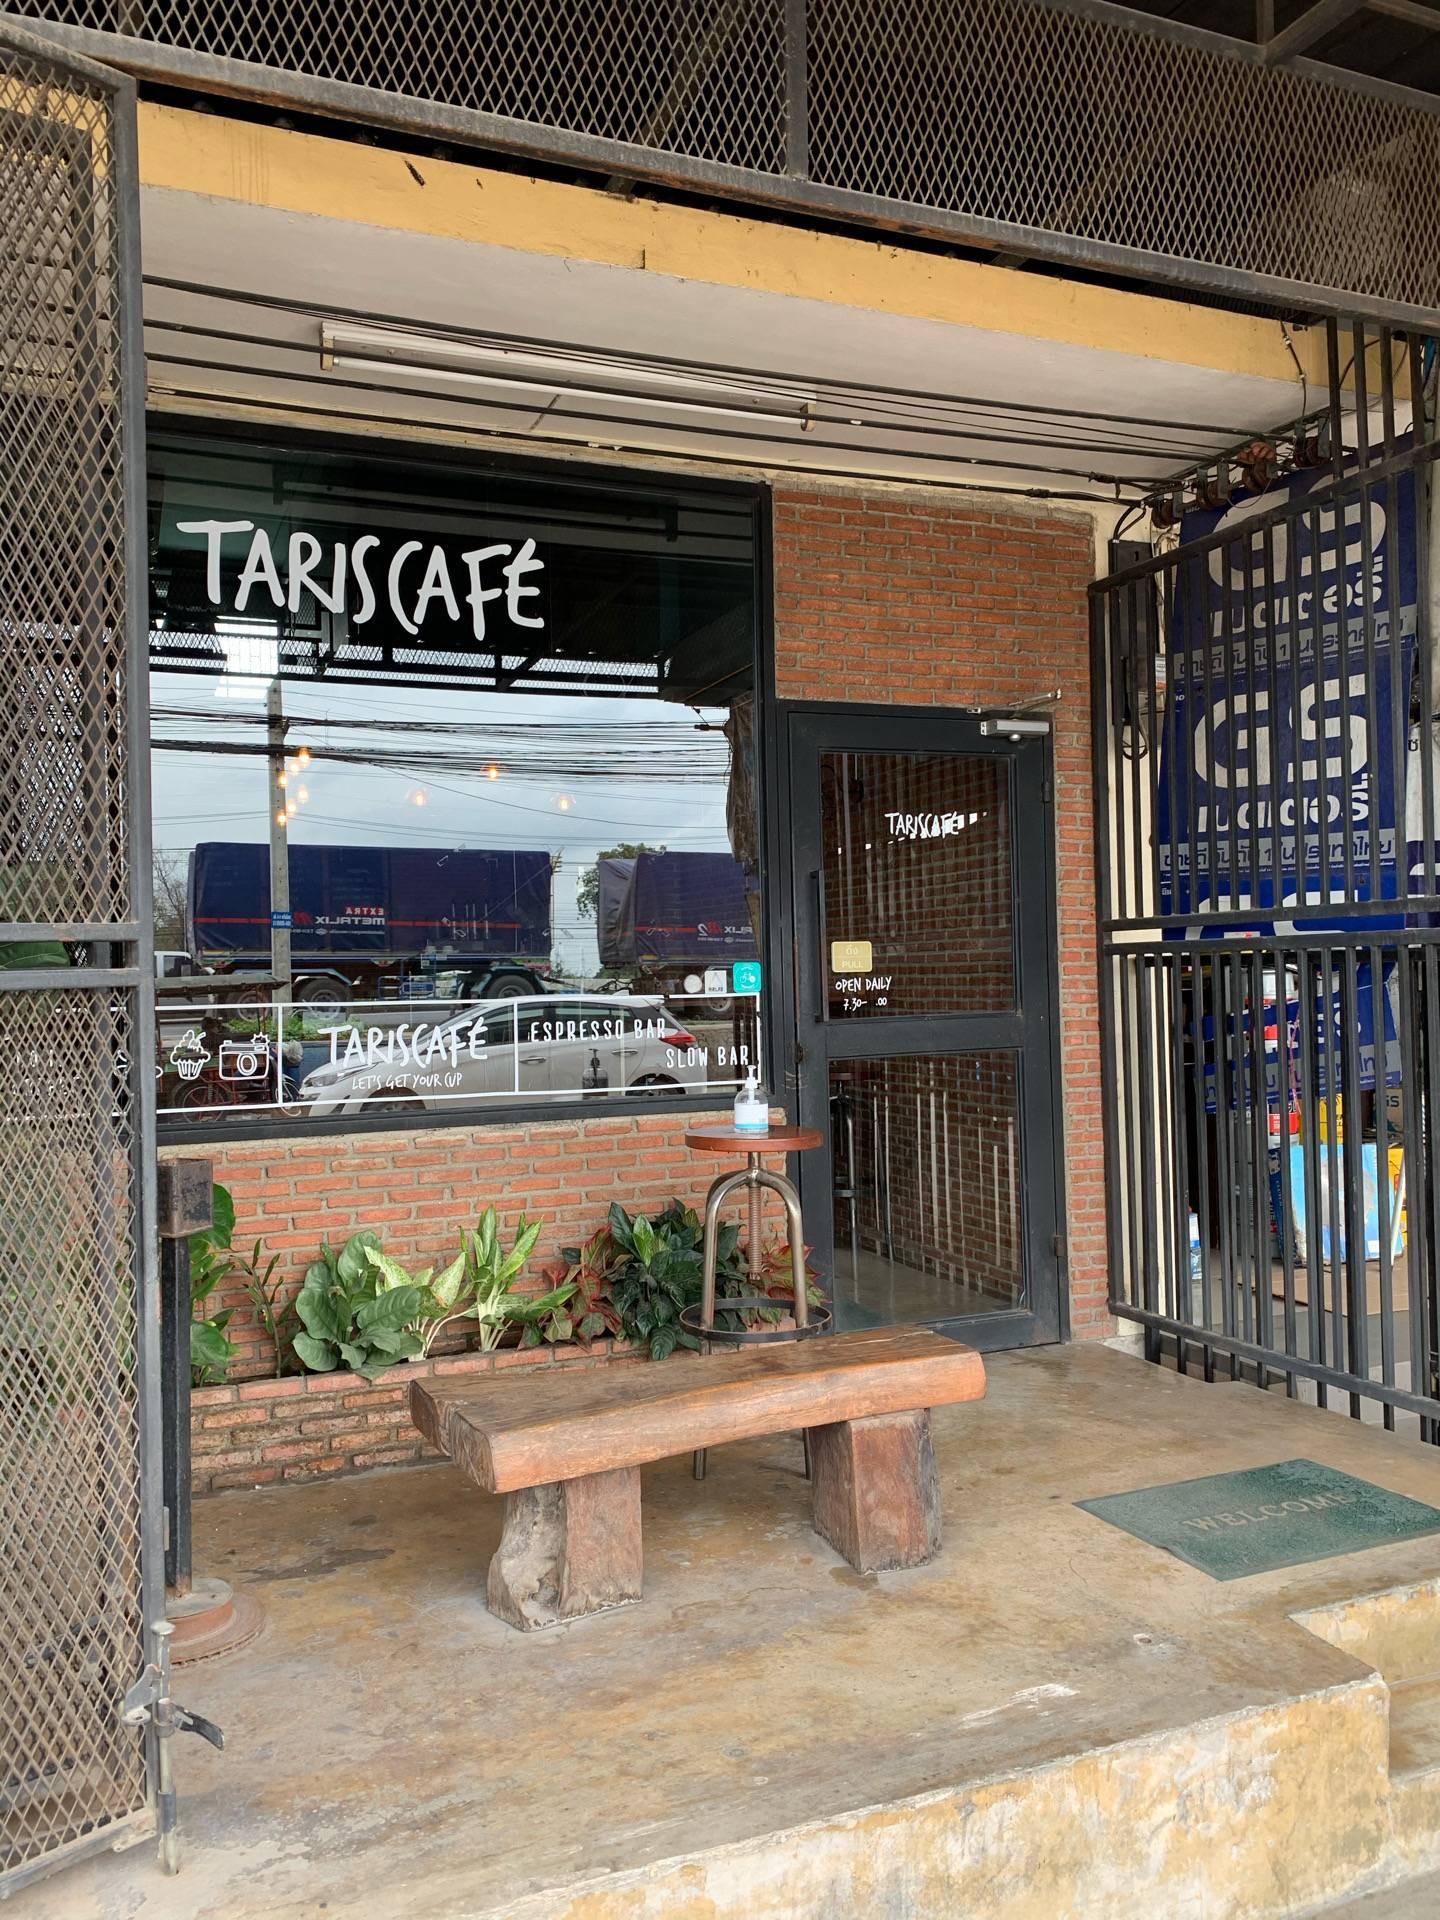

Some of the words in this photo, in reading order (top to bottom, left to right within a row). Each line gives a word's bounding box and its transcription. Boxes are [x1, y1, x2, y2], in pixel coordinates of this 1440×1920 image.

[841, 960, 864, 969] PULL
[835, 977, 862, 992] OPEN
[865, 976, 892, 991] DAILY
[530, 1019, 625, 1042] ESPRESSO
[633, 1018, 666, 1040] BAR
[666, 1047, 709, 1068] SLOW
[717, 1045, 749, 1066] BAR
[352, 1075, 381, 1091] LET'S
[385, 1073, 412, 1090] GET
[413, 1074, 442, 1088] YOUR
[444, 1072, 463, 1087] CUP
[1182, 1490, 1351, 1532] WELCOME
